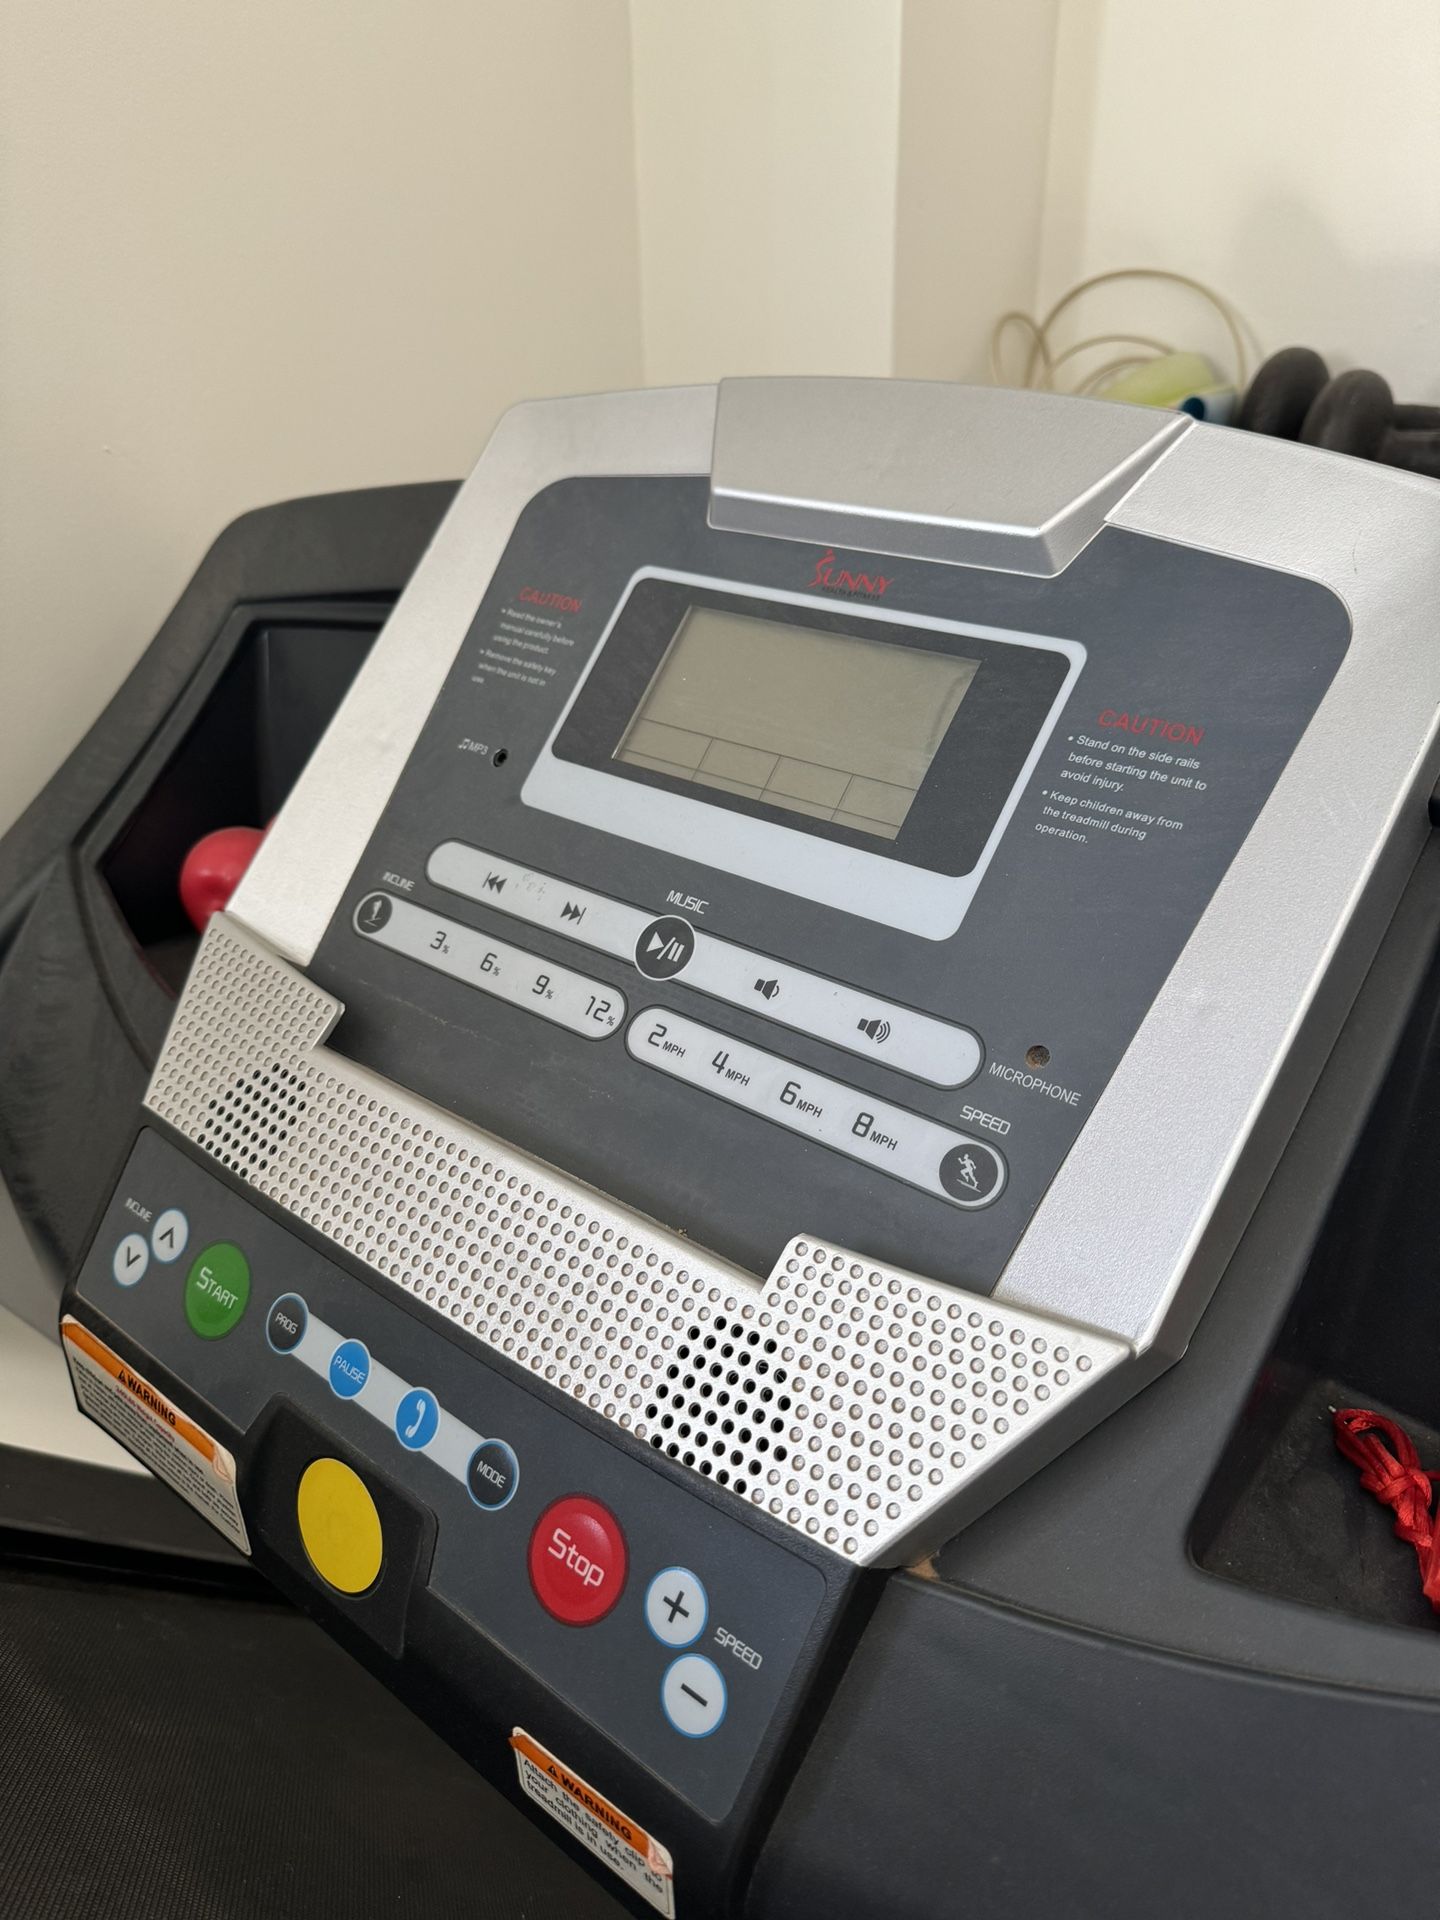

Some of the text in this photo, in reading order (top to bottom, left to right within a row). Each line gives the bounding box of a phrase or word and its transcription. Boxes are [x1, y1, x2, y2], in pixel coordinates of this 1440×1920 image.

[807, 549, 895, 594] SUNNY
[518, 586, 582, 613] CAUTION
[1097, 708, 1205, 747] CAUTION
[1068, 752, 1207, 791] before starting the unit to
[1076, 734, 1200, 770] Stand on the side rails
[1060, 769, 1125, 793] avoid injury.
[1042, 806, 1148, 841] the treadmill during
[1050, 790, 1184, 830] Keep children away from
[1035, 823, 1088, 843] operation.
[382, 871, 416, 892] INCLINE
[666, 889, 710, 914] MUSIC
[989, 1062, 1083, 1107] MICROPHONE
[959, 1105, 1012, 1136] SPEED
[196, 1266, 239, 1310] START
[275, 1312, 298, 1335] PROG
[333, 1355, 366, 1385] PAUSE
[127, 1373, 177, 1427] WARNING
[477, 1460, 506, 1489] MODE
[548, 1527, 605, 1588] Stop
[714, 1626, 763, 1670] SPEED
[523, 1759, 558, 1793] Attach
[562, 1792, 581, 1811] the
[585, 1812, 620, 1845] safety
[624, 1846, 646, 1868] clip
[526, 1780, 573, 1826] treadmill
[574, 1822, 585, 1836] is
[586, 1833, 598, 1848] in
[561, 1774, 632, 1841] WARNING
[525, 1770, 664, 1894] your clothing when the
